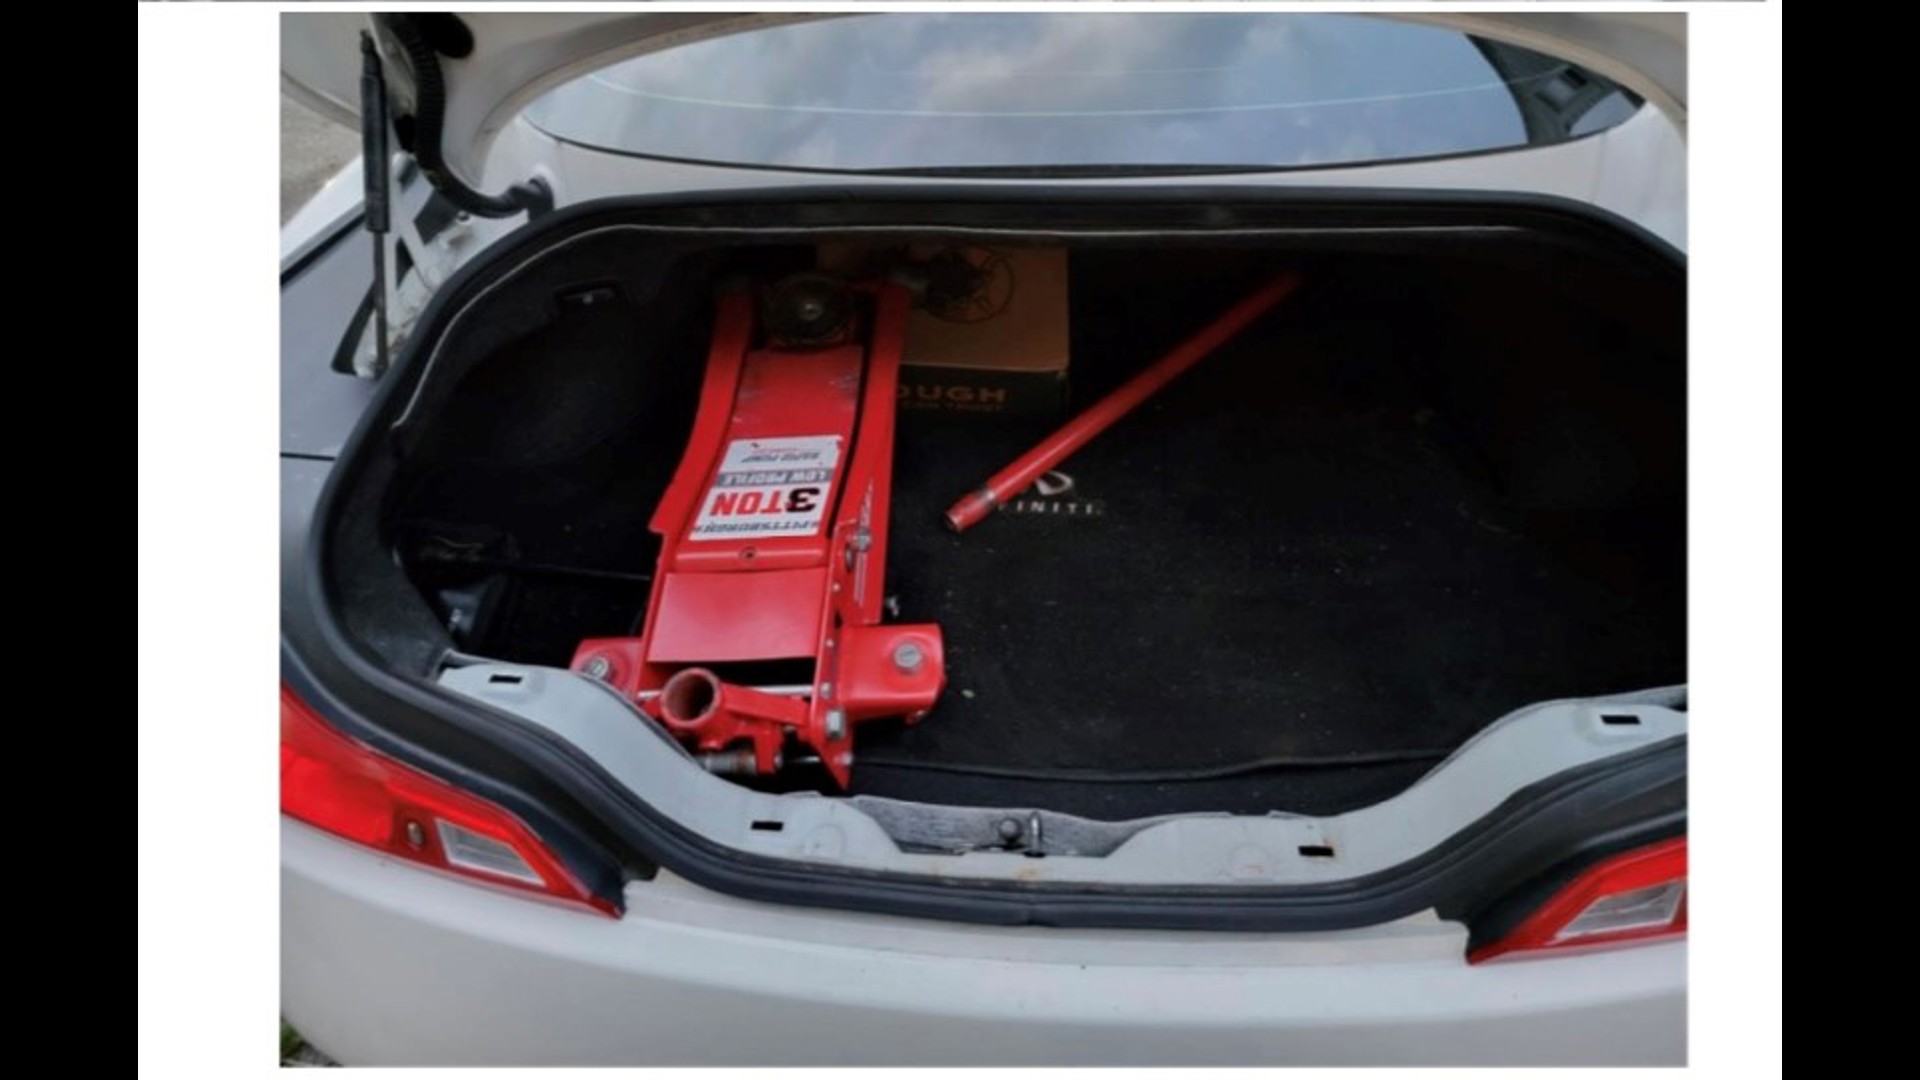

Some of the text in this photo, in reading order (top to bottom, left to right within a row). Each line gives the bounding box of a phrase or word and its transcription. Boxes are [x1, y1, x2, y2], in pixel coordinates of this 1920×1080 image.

[722, 471, 827, 486] LOW PROFILE
[998, 501, 1093, 514] INITI
